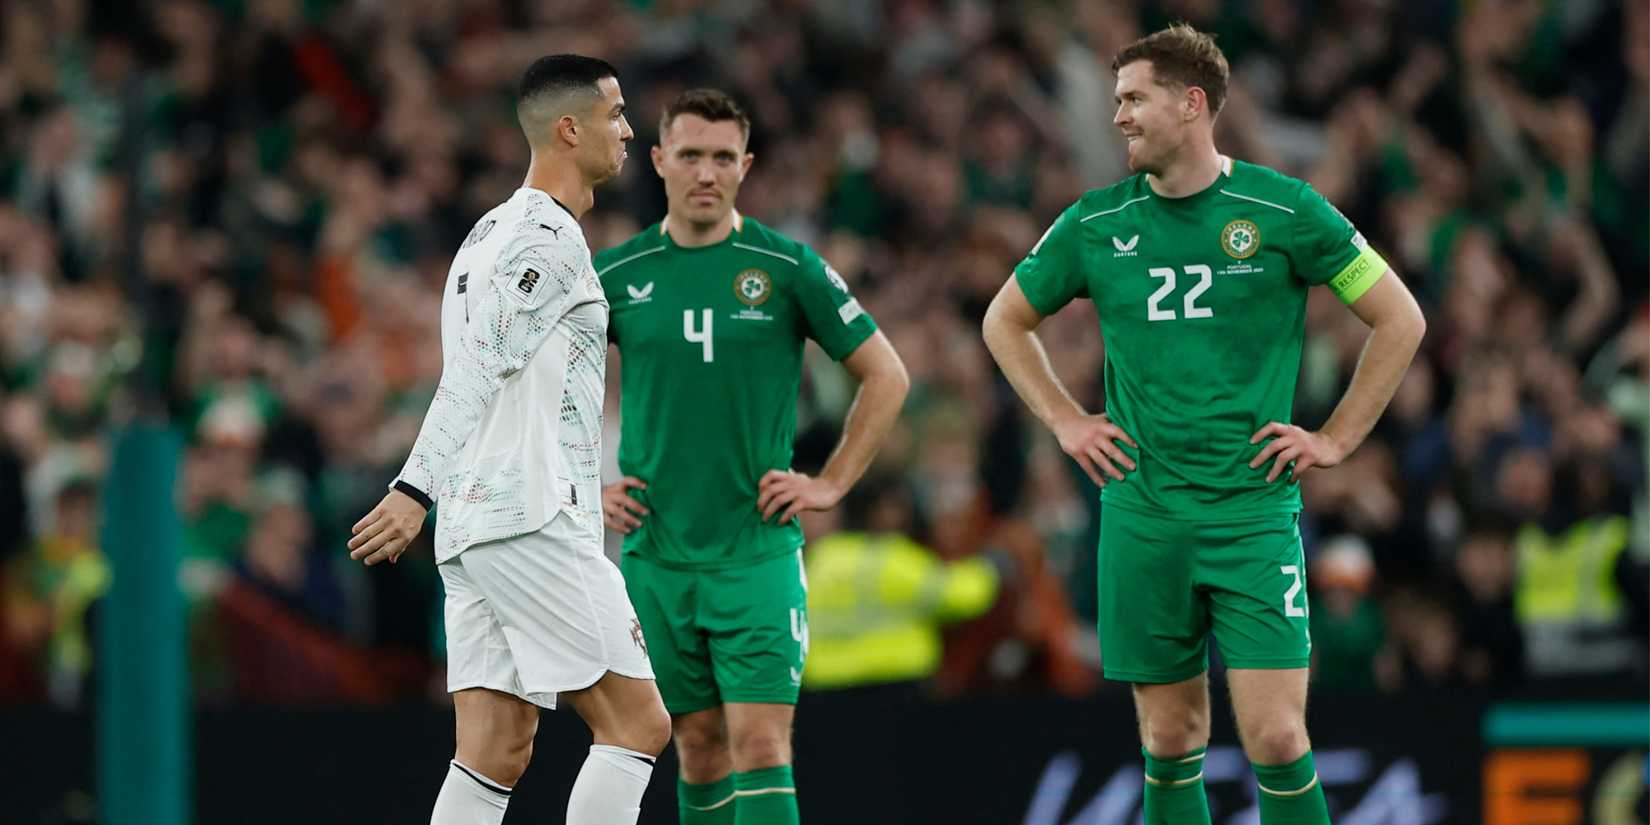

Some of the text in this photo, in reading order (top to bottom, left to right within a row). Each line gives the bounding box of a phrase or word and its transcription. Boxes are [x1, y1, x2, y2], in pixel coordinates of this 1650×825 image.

[1147, 263, 1214, 321] 22
[1335, 257, 1370, 290] RESPECT
[683, 308, 713, 362] 4
